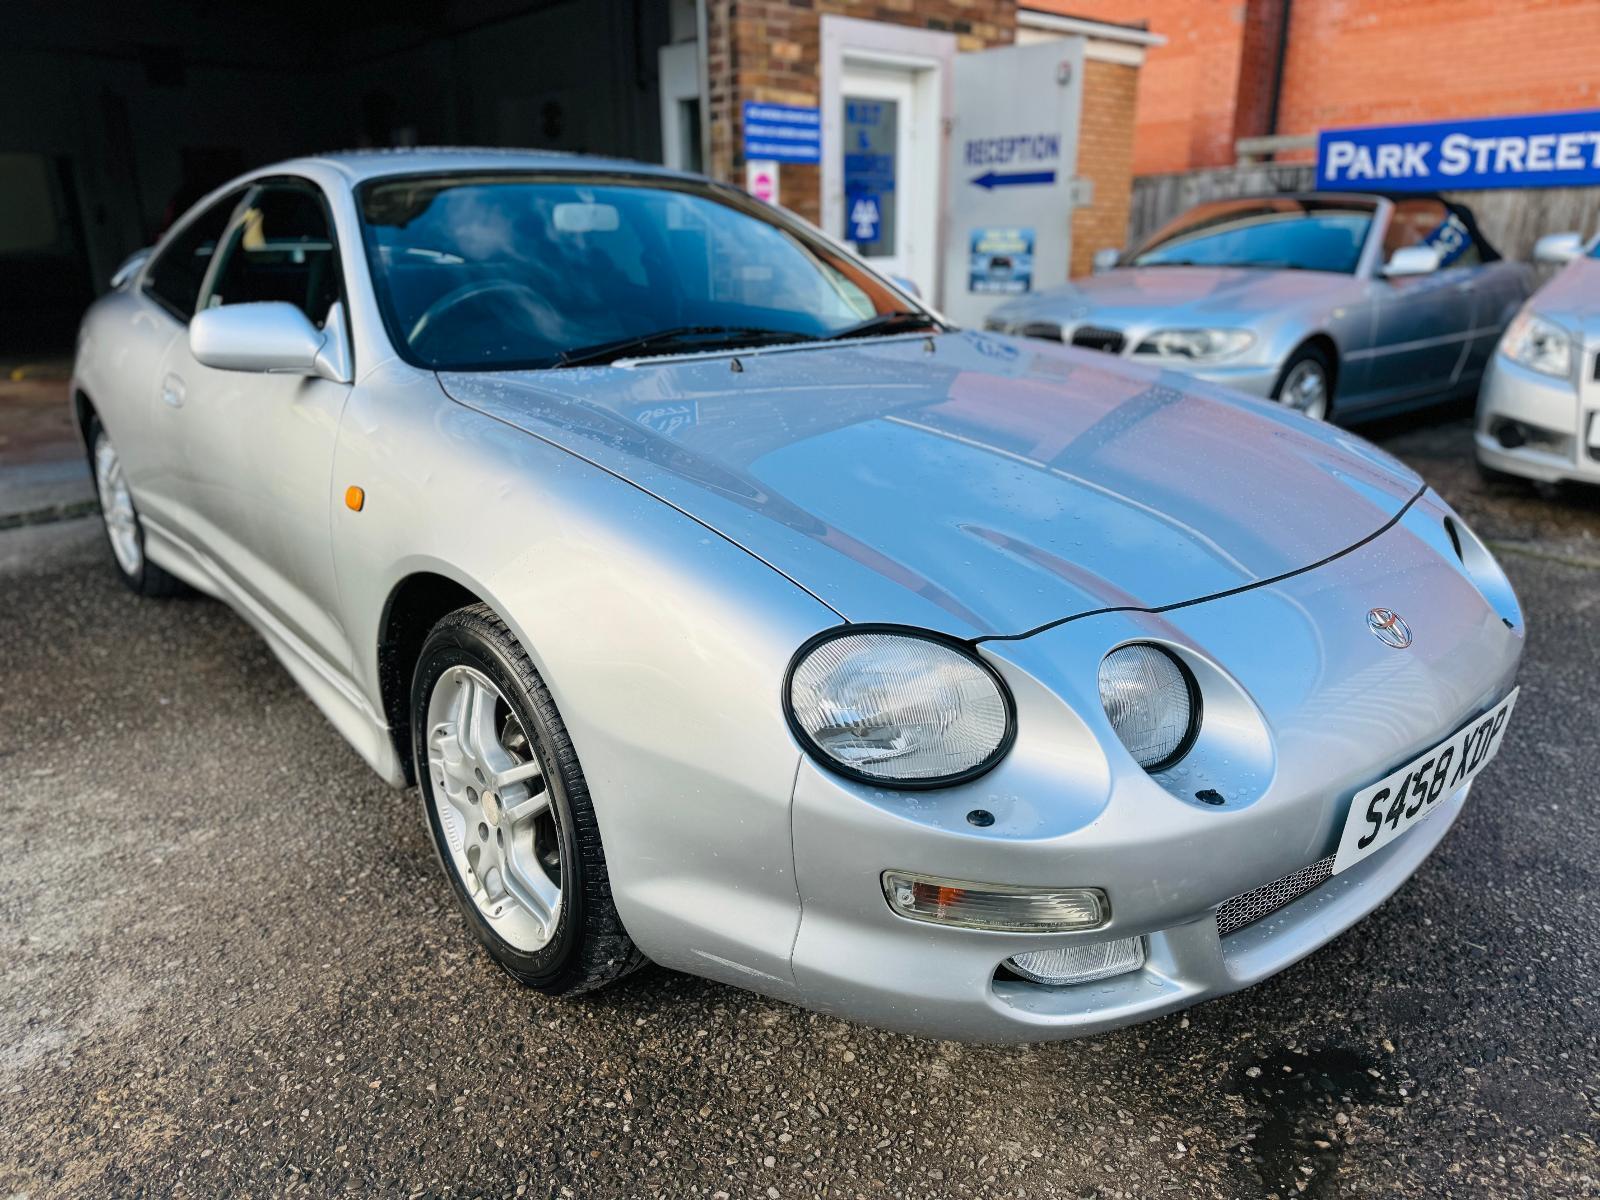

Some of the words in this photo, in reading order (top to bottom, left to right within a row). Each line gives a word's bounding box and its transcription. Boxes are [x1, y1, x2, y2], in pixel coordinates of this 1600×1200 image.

[965, 133, 1061, 165] RECEPTION
[1325, 141, 1432, 181] PARK
[1358, 746, 1454, 849] S458
[1450, 705, 1508, 788] XDP
